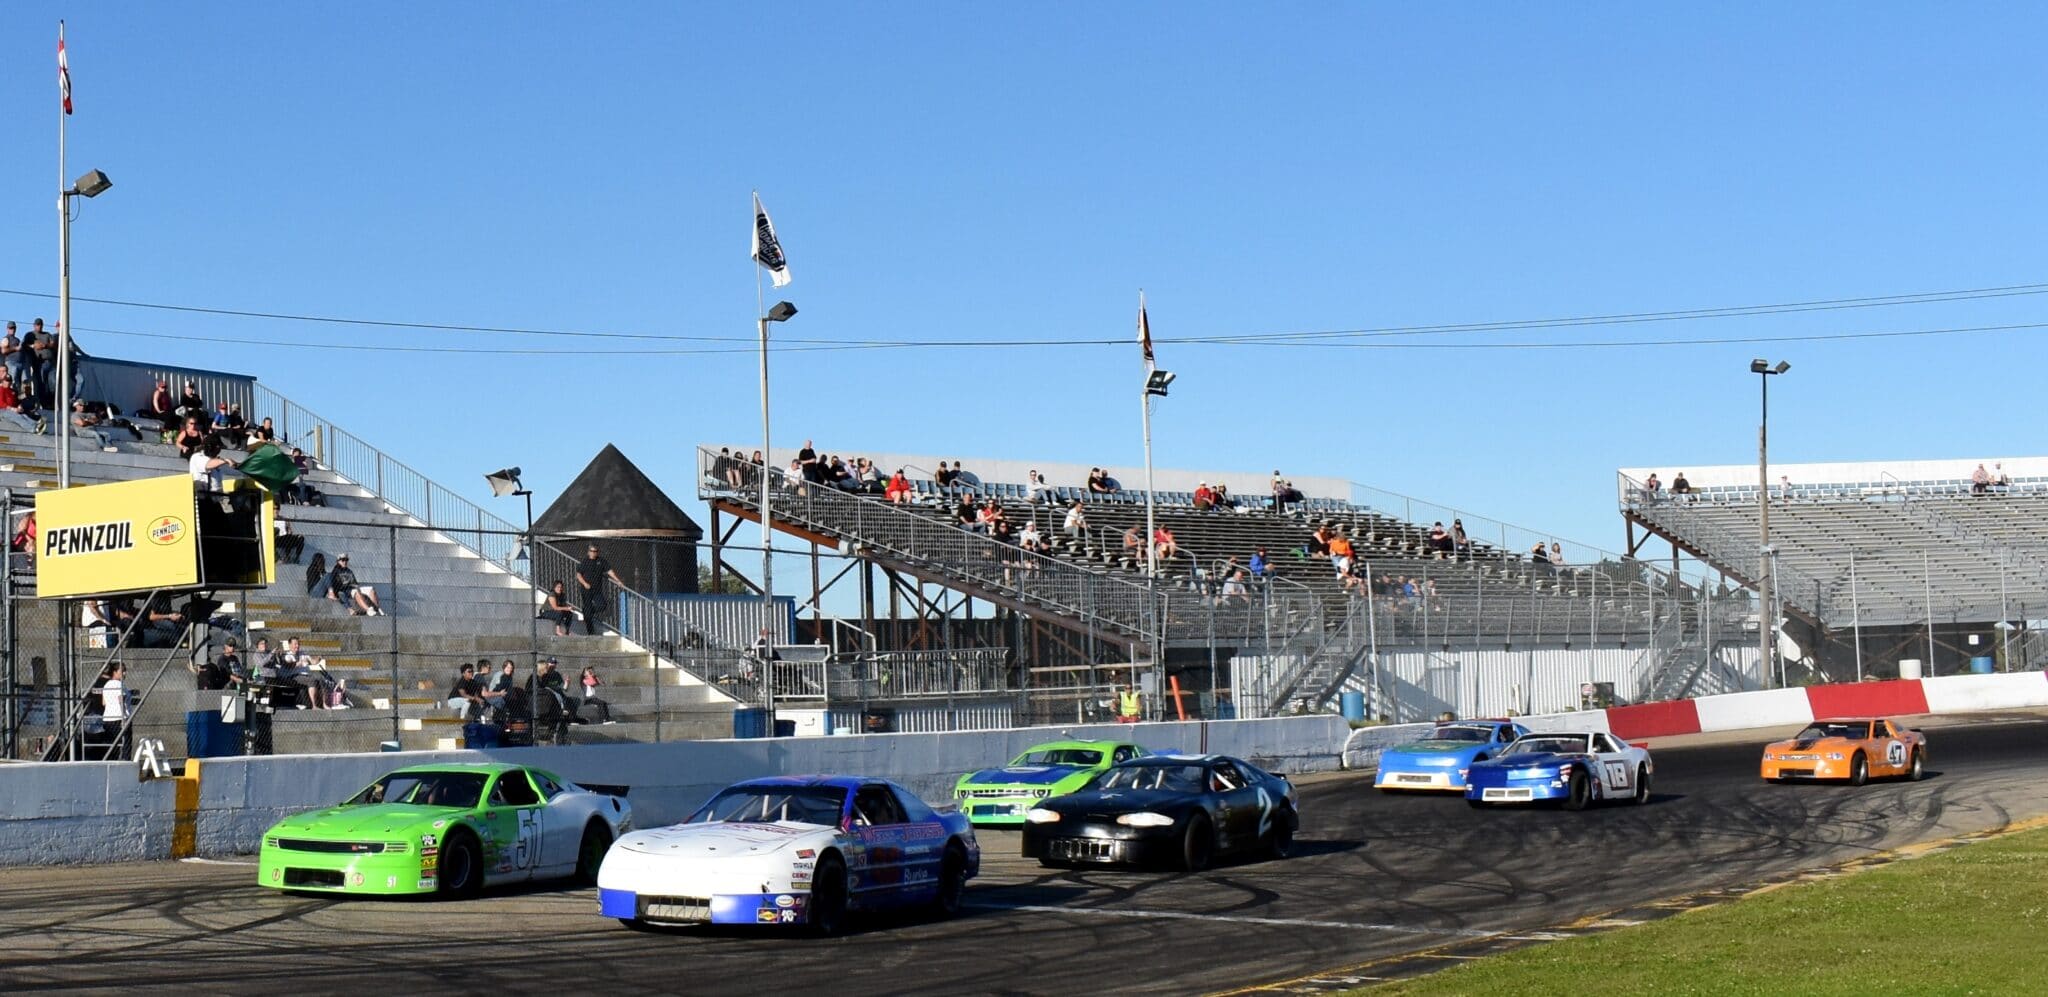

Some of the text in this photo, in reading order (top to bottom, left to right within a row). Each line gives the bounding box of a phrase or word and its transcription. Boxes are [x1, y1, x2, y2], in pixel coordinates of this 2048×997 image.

[46, 522, 133, 556] PENNZOIL
[152, 523, 181, 538] PENNZOIL
[1889, 744, 1902, 764] 47
[1603, 761, 1630, 790] 18
[1257, 787, 1273, 840] 2
[516, 808, 543, 870] 51
